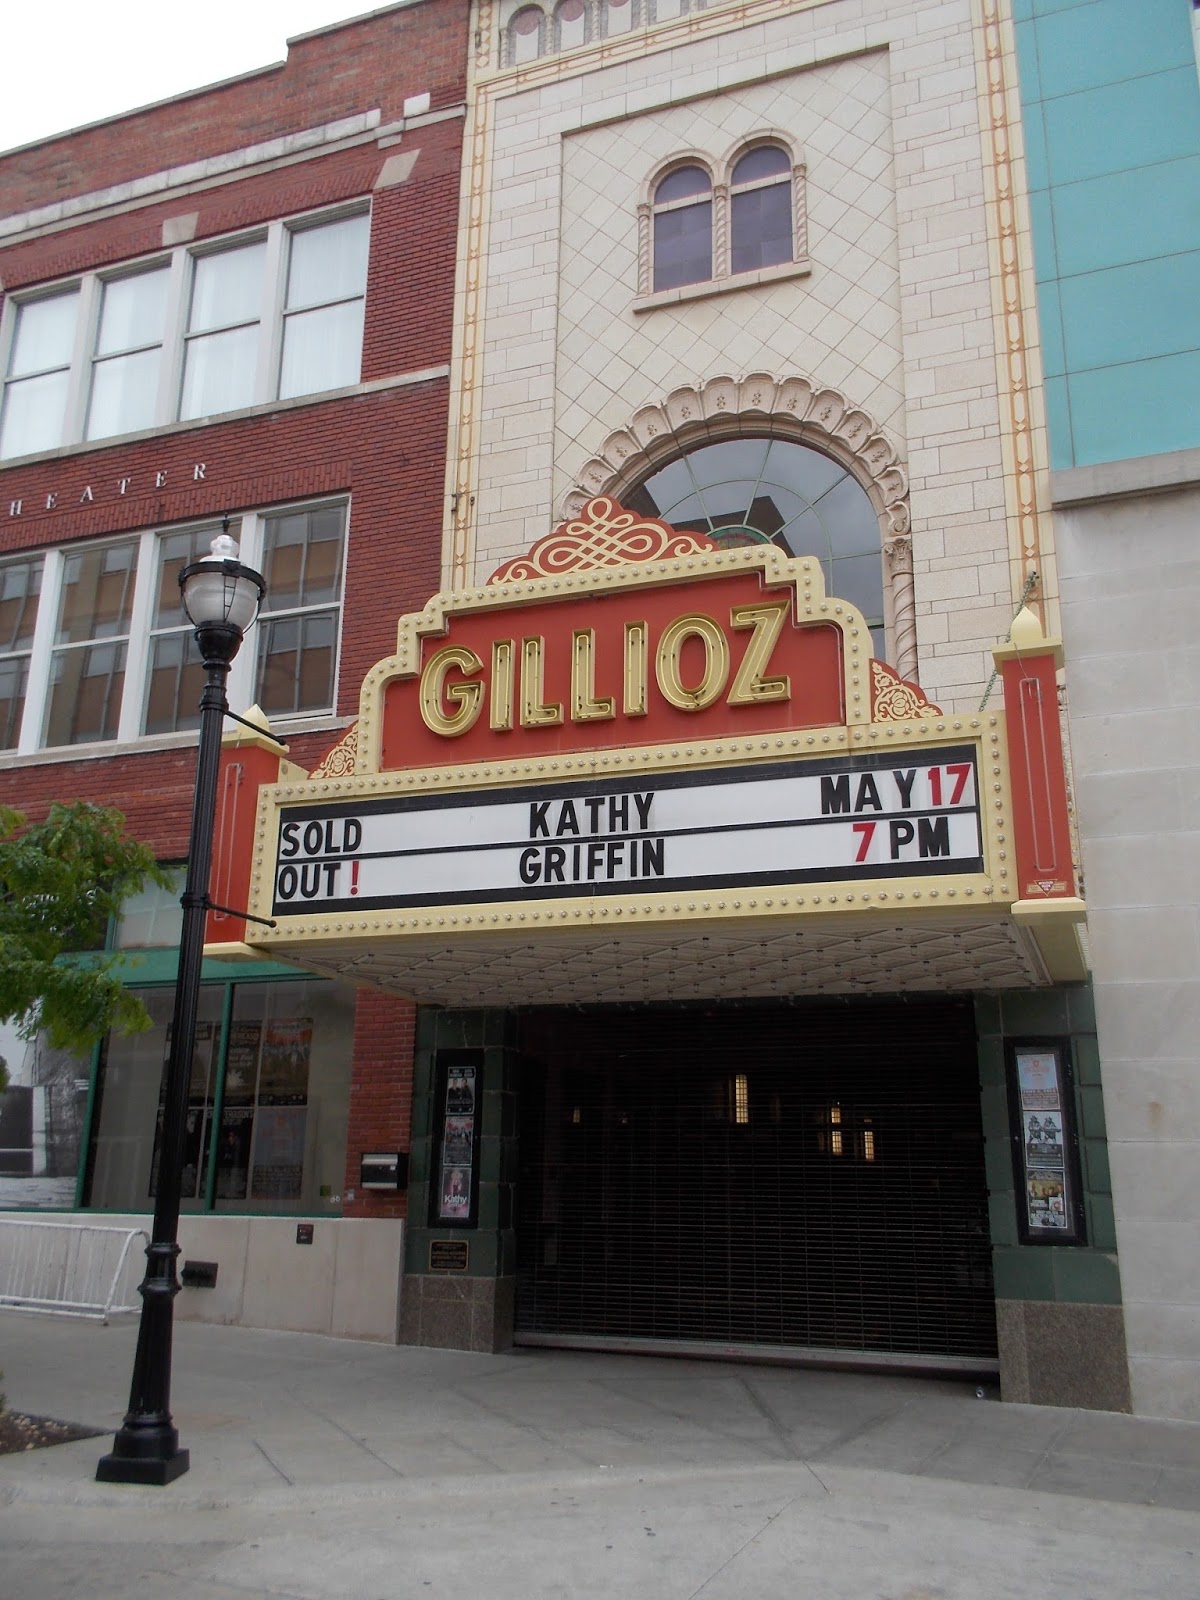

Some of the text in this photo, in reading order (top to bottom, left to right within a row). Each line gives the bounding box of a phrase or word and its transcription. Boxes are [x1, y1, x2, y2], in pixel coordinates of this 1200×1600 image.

[418, 599, 792, 738] GILLIOZ
[820, 763, 971, 815] MAY 17
[279, 818, 363, 858] SOLD
[529, 792, 655, 839] KATHY
[518, 838, 665, 885] GRIFFIN
[852, 816, 951, 863] 7 PM
